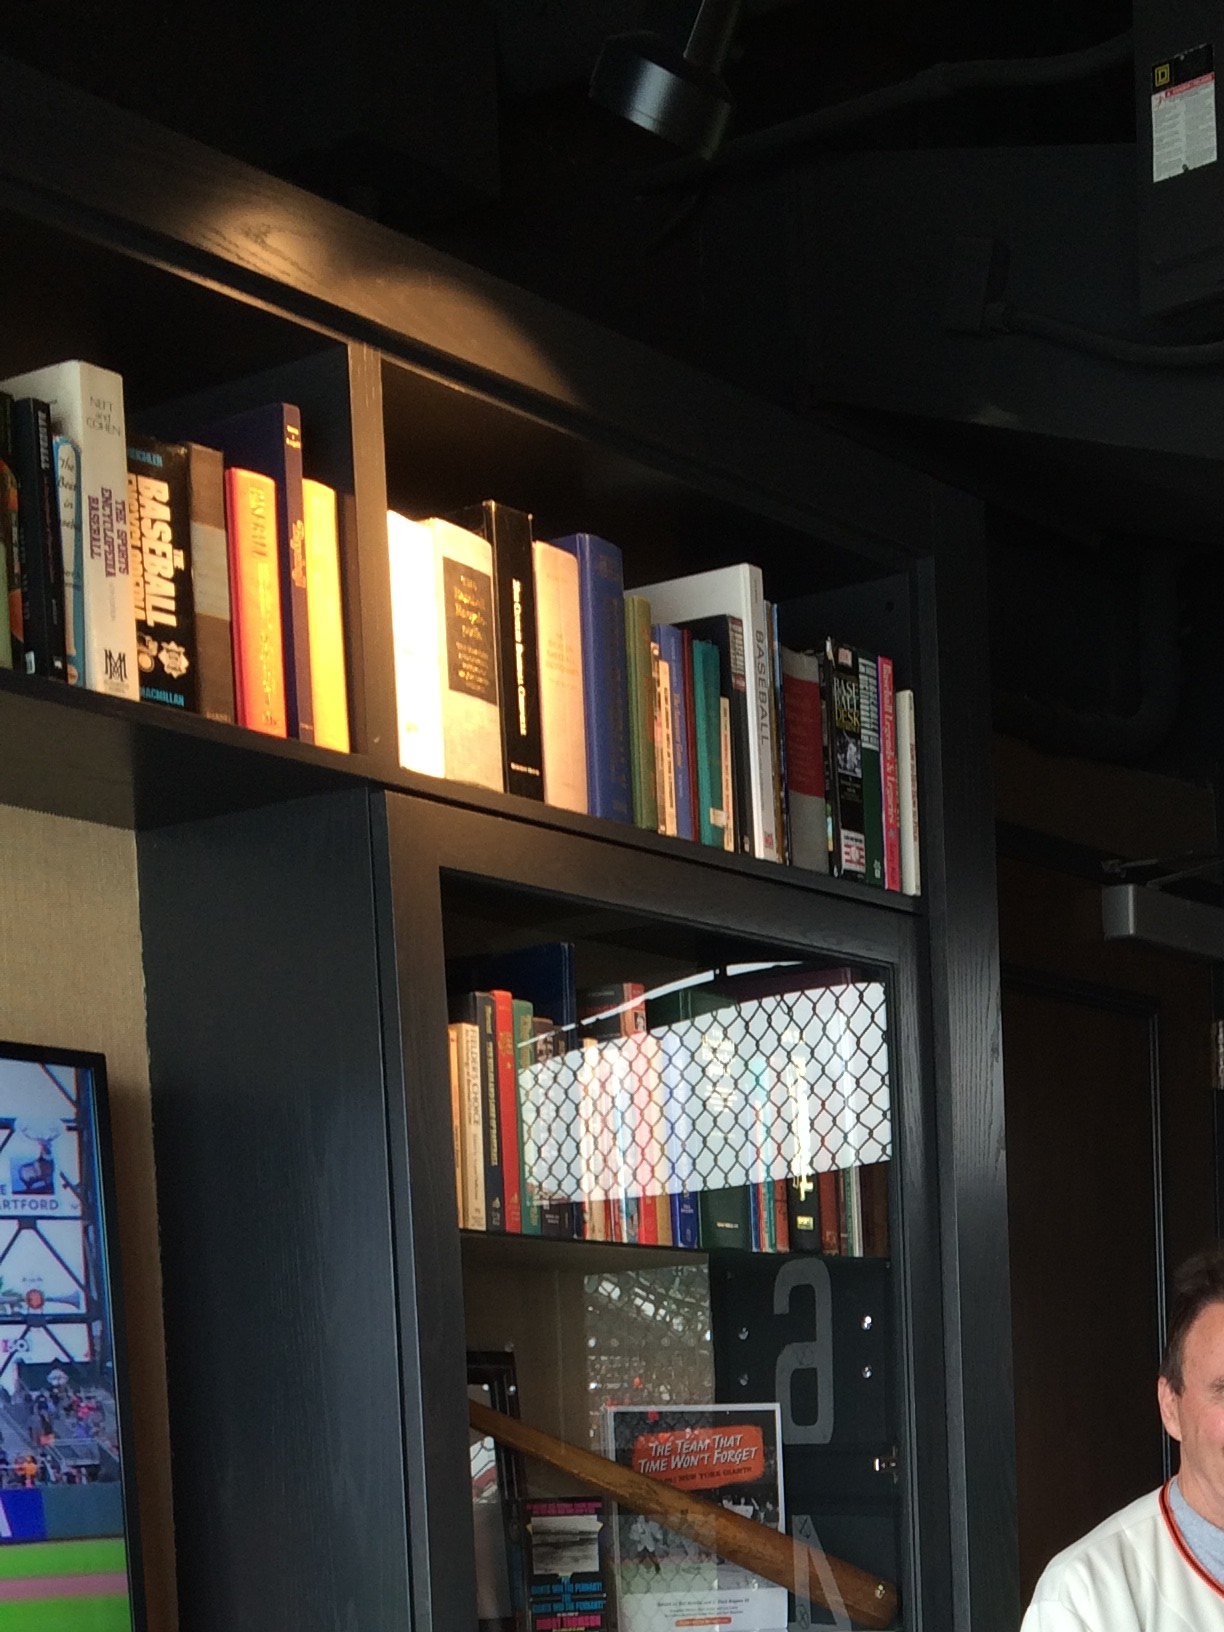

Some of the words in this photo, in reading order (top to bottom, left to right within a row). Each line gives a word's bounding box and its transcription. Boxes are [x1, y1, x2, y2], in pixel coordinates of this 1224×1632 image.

[86, 417, 121, 437] COHEN
[87, 494, 102, 560] BASEBALL
[101, 486, 116, 578] ENCYCLOPEDIA
[115, 500, 126, 524] THE
[118, 529, 129, 576] SPORTS
[136, 475, 178, 628] BASEBALL
[173, 548, 185, 571] THE
[754, 629, 771, 746] BASEBALL
[882, 664, 893, 713] Baseball
[835, 707, 860, 727] DESK
[884, 713, 894, 759] Legends
[885, 774, 896, 824] Legacies
[470, 1028, 479, 1080] FIELDER'S
[472, 1081, 481, 1127] CHOICE
[0, 1198, 59, 1211] RTFORD
[638, 1458, 668, 1475] TIME
[671, 1453, 710, 1470] WON'T
[712, 1447, 758, 1465] FORGET
[649, 1440, 672, 1457] THE
[675, 1437, 710, 1454] TEAM
[712, 1434, 743, 1449] THAT
[699, 1471, 721, 1479] YORK
